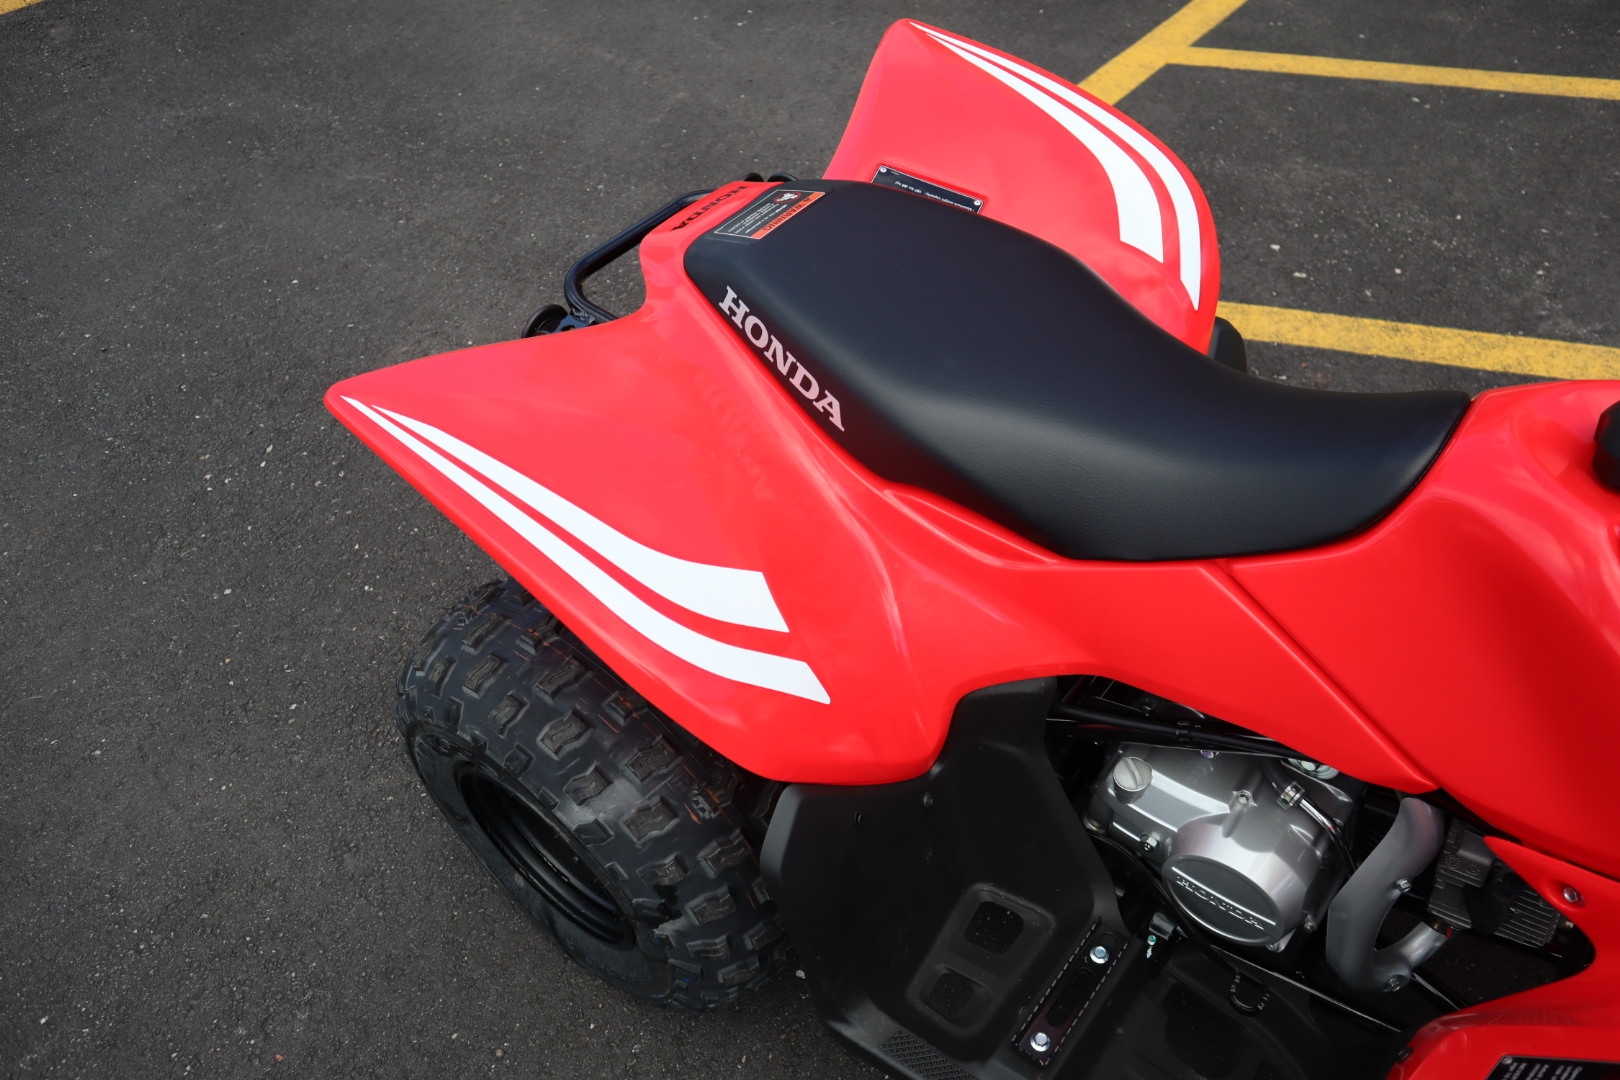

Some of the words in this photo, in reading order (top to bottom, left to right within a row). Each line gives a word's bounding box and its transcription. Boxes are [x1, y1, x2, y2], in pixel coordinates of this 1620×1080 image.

[670, 185, 749, 232] HONDA
[762, 202, 803, 232] WARNING
[718, 285, 845, 432] HONDA
[1175, 875, 1265, 931] HONDA
